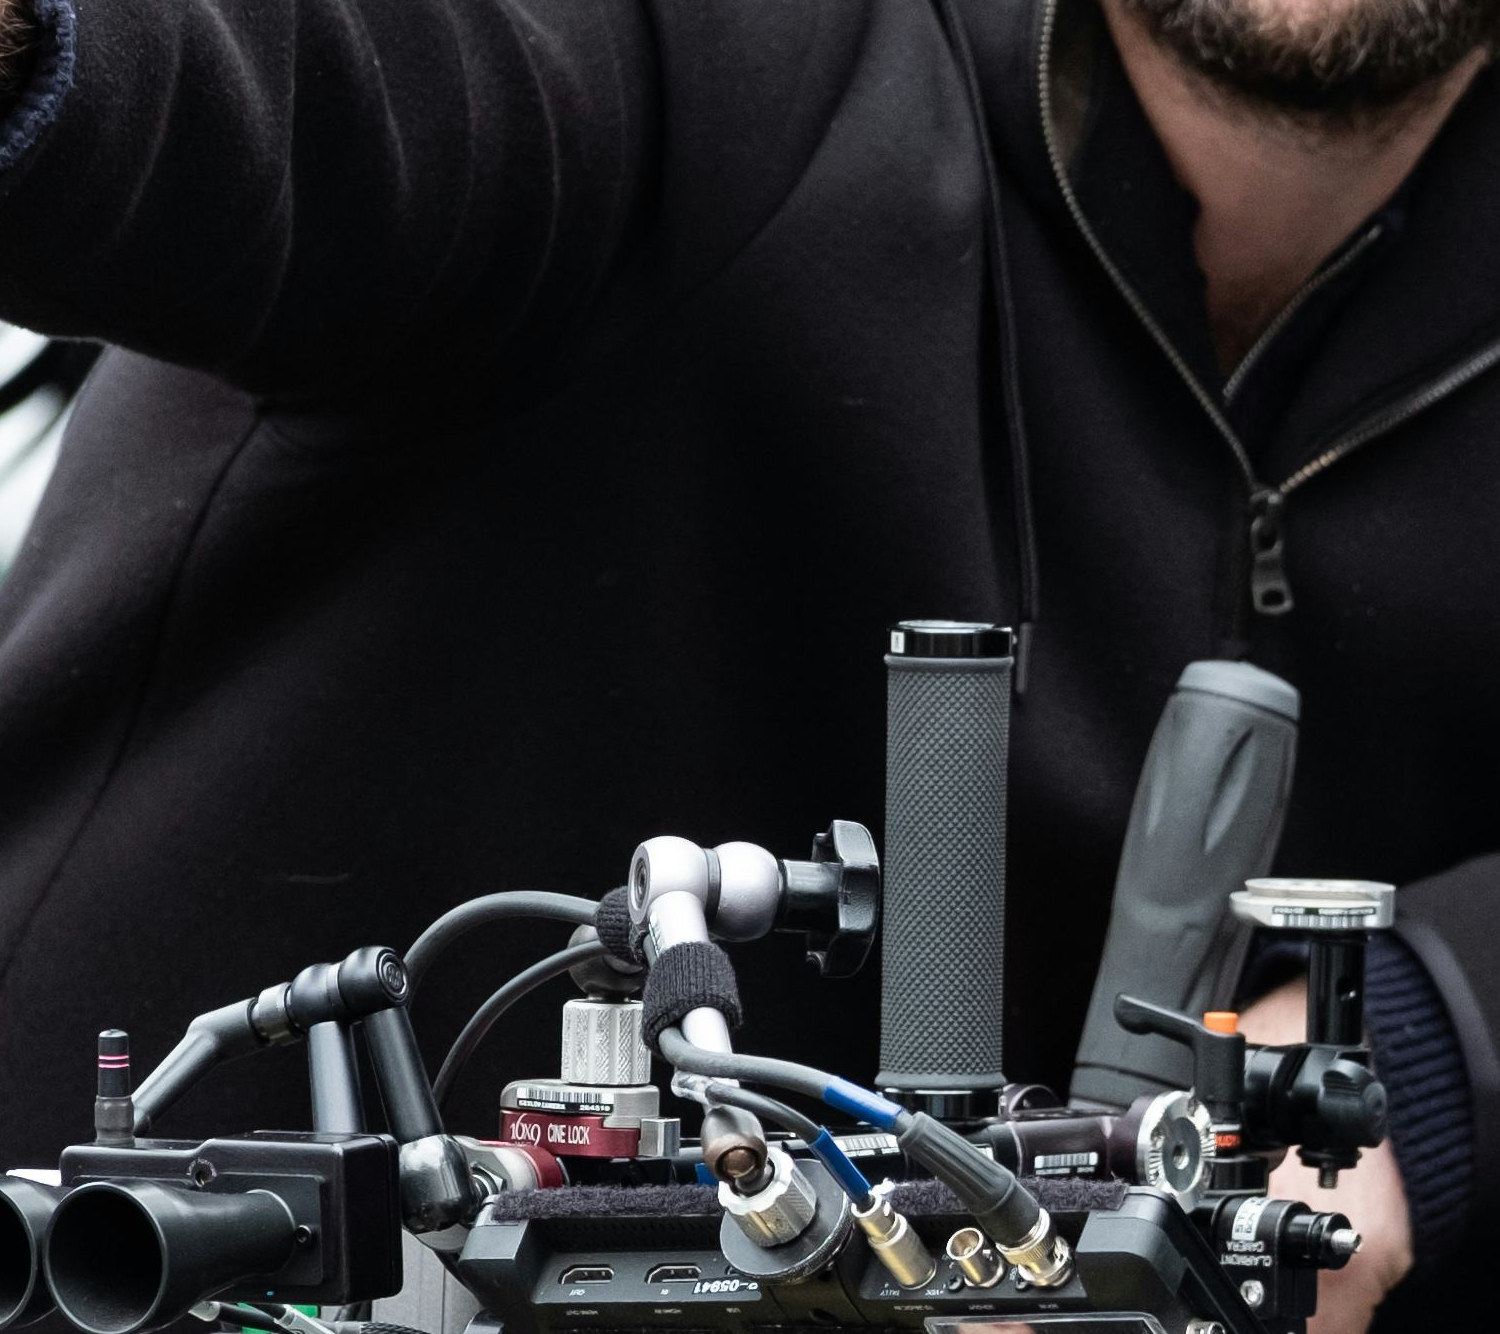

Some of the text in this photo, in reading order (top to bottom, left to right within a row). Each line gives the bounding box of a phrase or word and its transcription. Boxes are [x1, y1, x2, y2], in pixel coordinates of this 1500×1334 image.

[547, 1123, 566, 1144] CINE
[567, 1125, 590, 1145] LOCK
[1226, 1240, 1265, 1252] CAMERA
[1219, 1253, 1272, 1267] CLAIRMONT
